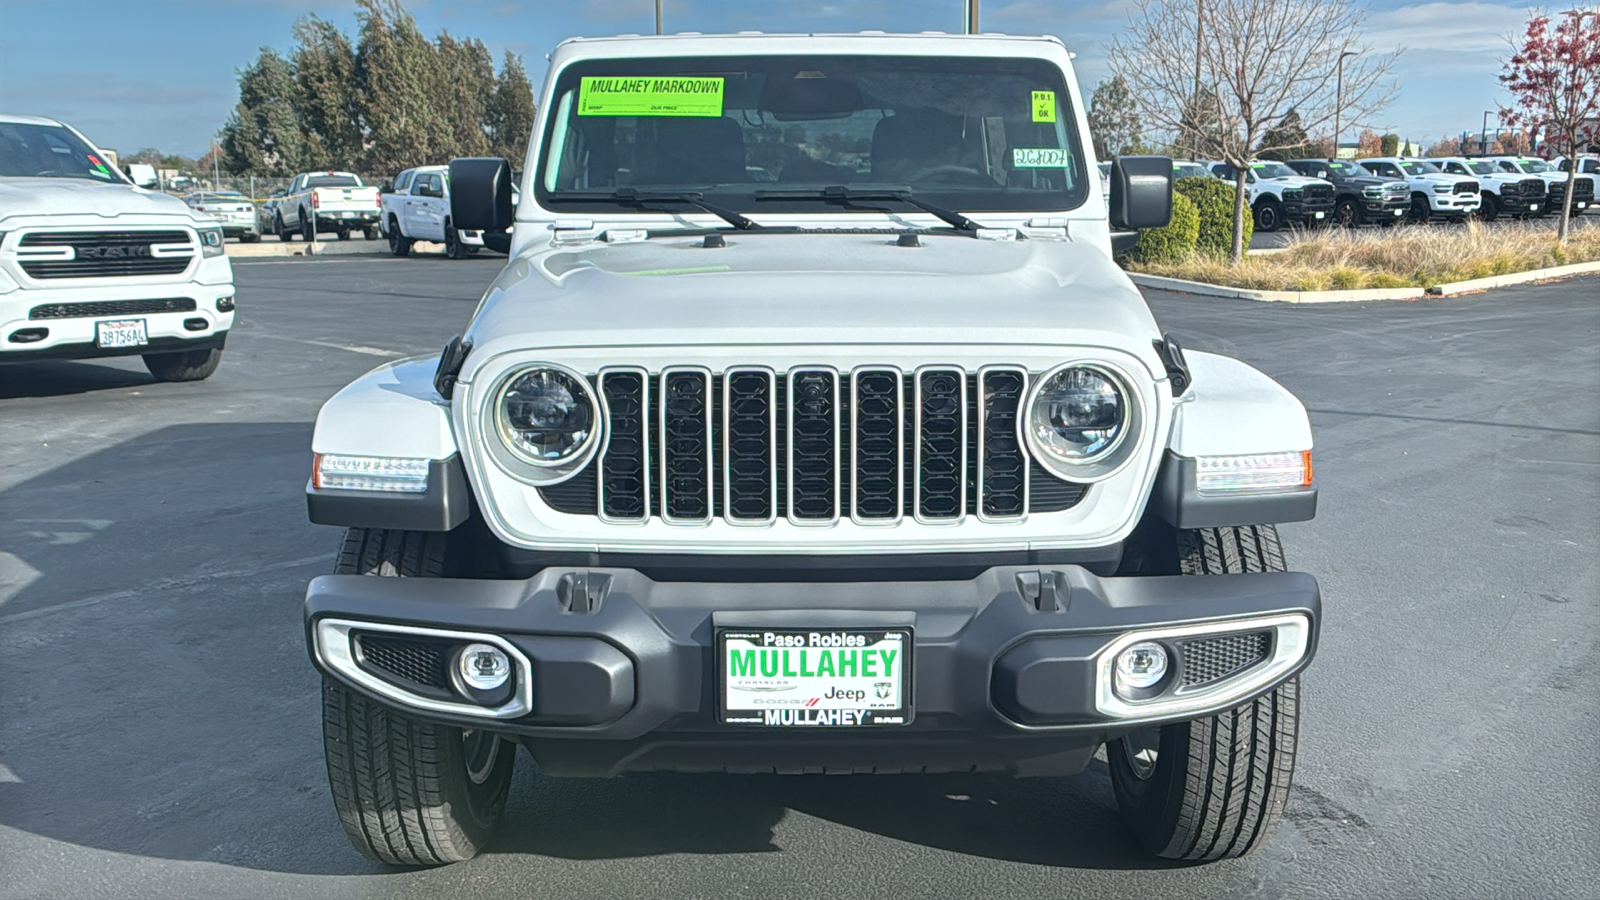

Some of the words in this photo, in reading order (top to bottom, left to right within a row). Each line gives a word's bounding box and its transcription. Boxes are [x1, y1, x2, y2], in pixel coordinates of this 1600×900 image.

[590, 80, 651, 93] MULLAHEY
[652, 80, 720, 93] MARKDOWN
[77, 245, 150, 259] RAM
[763, 632, 805, 647] Paso
[809, 632, 866, 647] Robles
[884, 632, 902, 641] Jeep
[730, 649, 898, 677] MULLAHEY
[824, 686, 866, 701] Jeep
[765, 709, 866, 725] MULLAHEY
